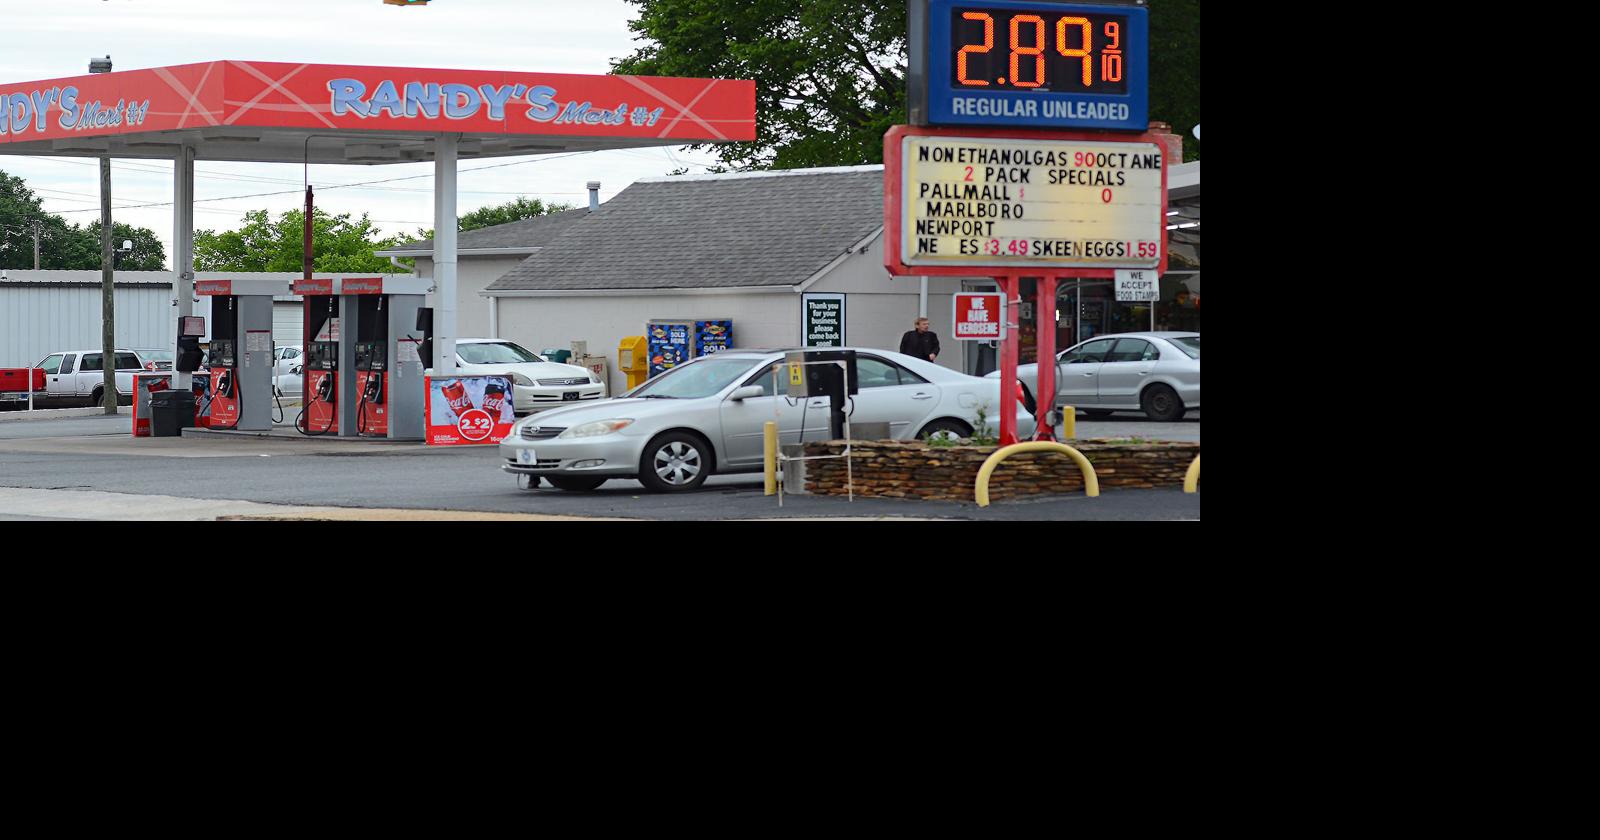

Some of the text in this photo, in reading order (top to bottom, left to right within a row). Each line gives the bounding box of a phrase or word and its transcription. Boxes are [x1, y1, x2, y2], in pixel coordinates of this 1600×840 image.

[957, 12, 1092, 87] 2.89
[328, 78, 664, 127] RANDY'S Mart #1
[953, 97, 1129, 121] REGULAR UNLEADED
[77, 99, 124, 131] Mart
[126, 99, 149, 125] #1
[964, 166, 1125, 186] 2 PACK SPECIALS
[926, 202, 1024, 219] MARLBORO
[916, 220, 995, 237] NEWPORT
[918, 238, 938, 253] NE
[960, 239, 979, 255] ES
[984, 239, 1029, 256] $3.49
[1130, 271, 1144, 280] WE
[1120, 281, 1152, 290] ACCEPT
[1115, 290, 1159, 301] FOOD STAMPS
[808, 301, 839, 311] Thank you
[971, 297, 985, 310] WE
[812, 309, 837, 320] for your
[967, 309, 989, 322] HAVE
[813, 324, 834, 334] please
[825, 332, 840, 340] back
[461, 418, 471, 430] 2
